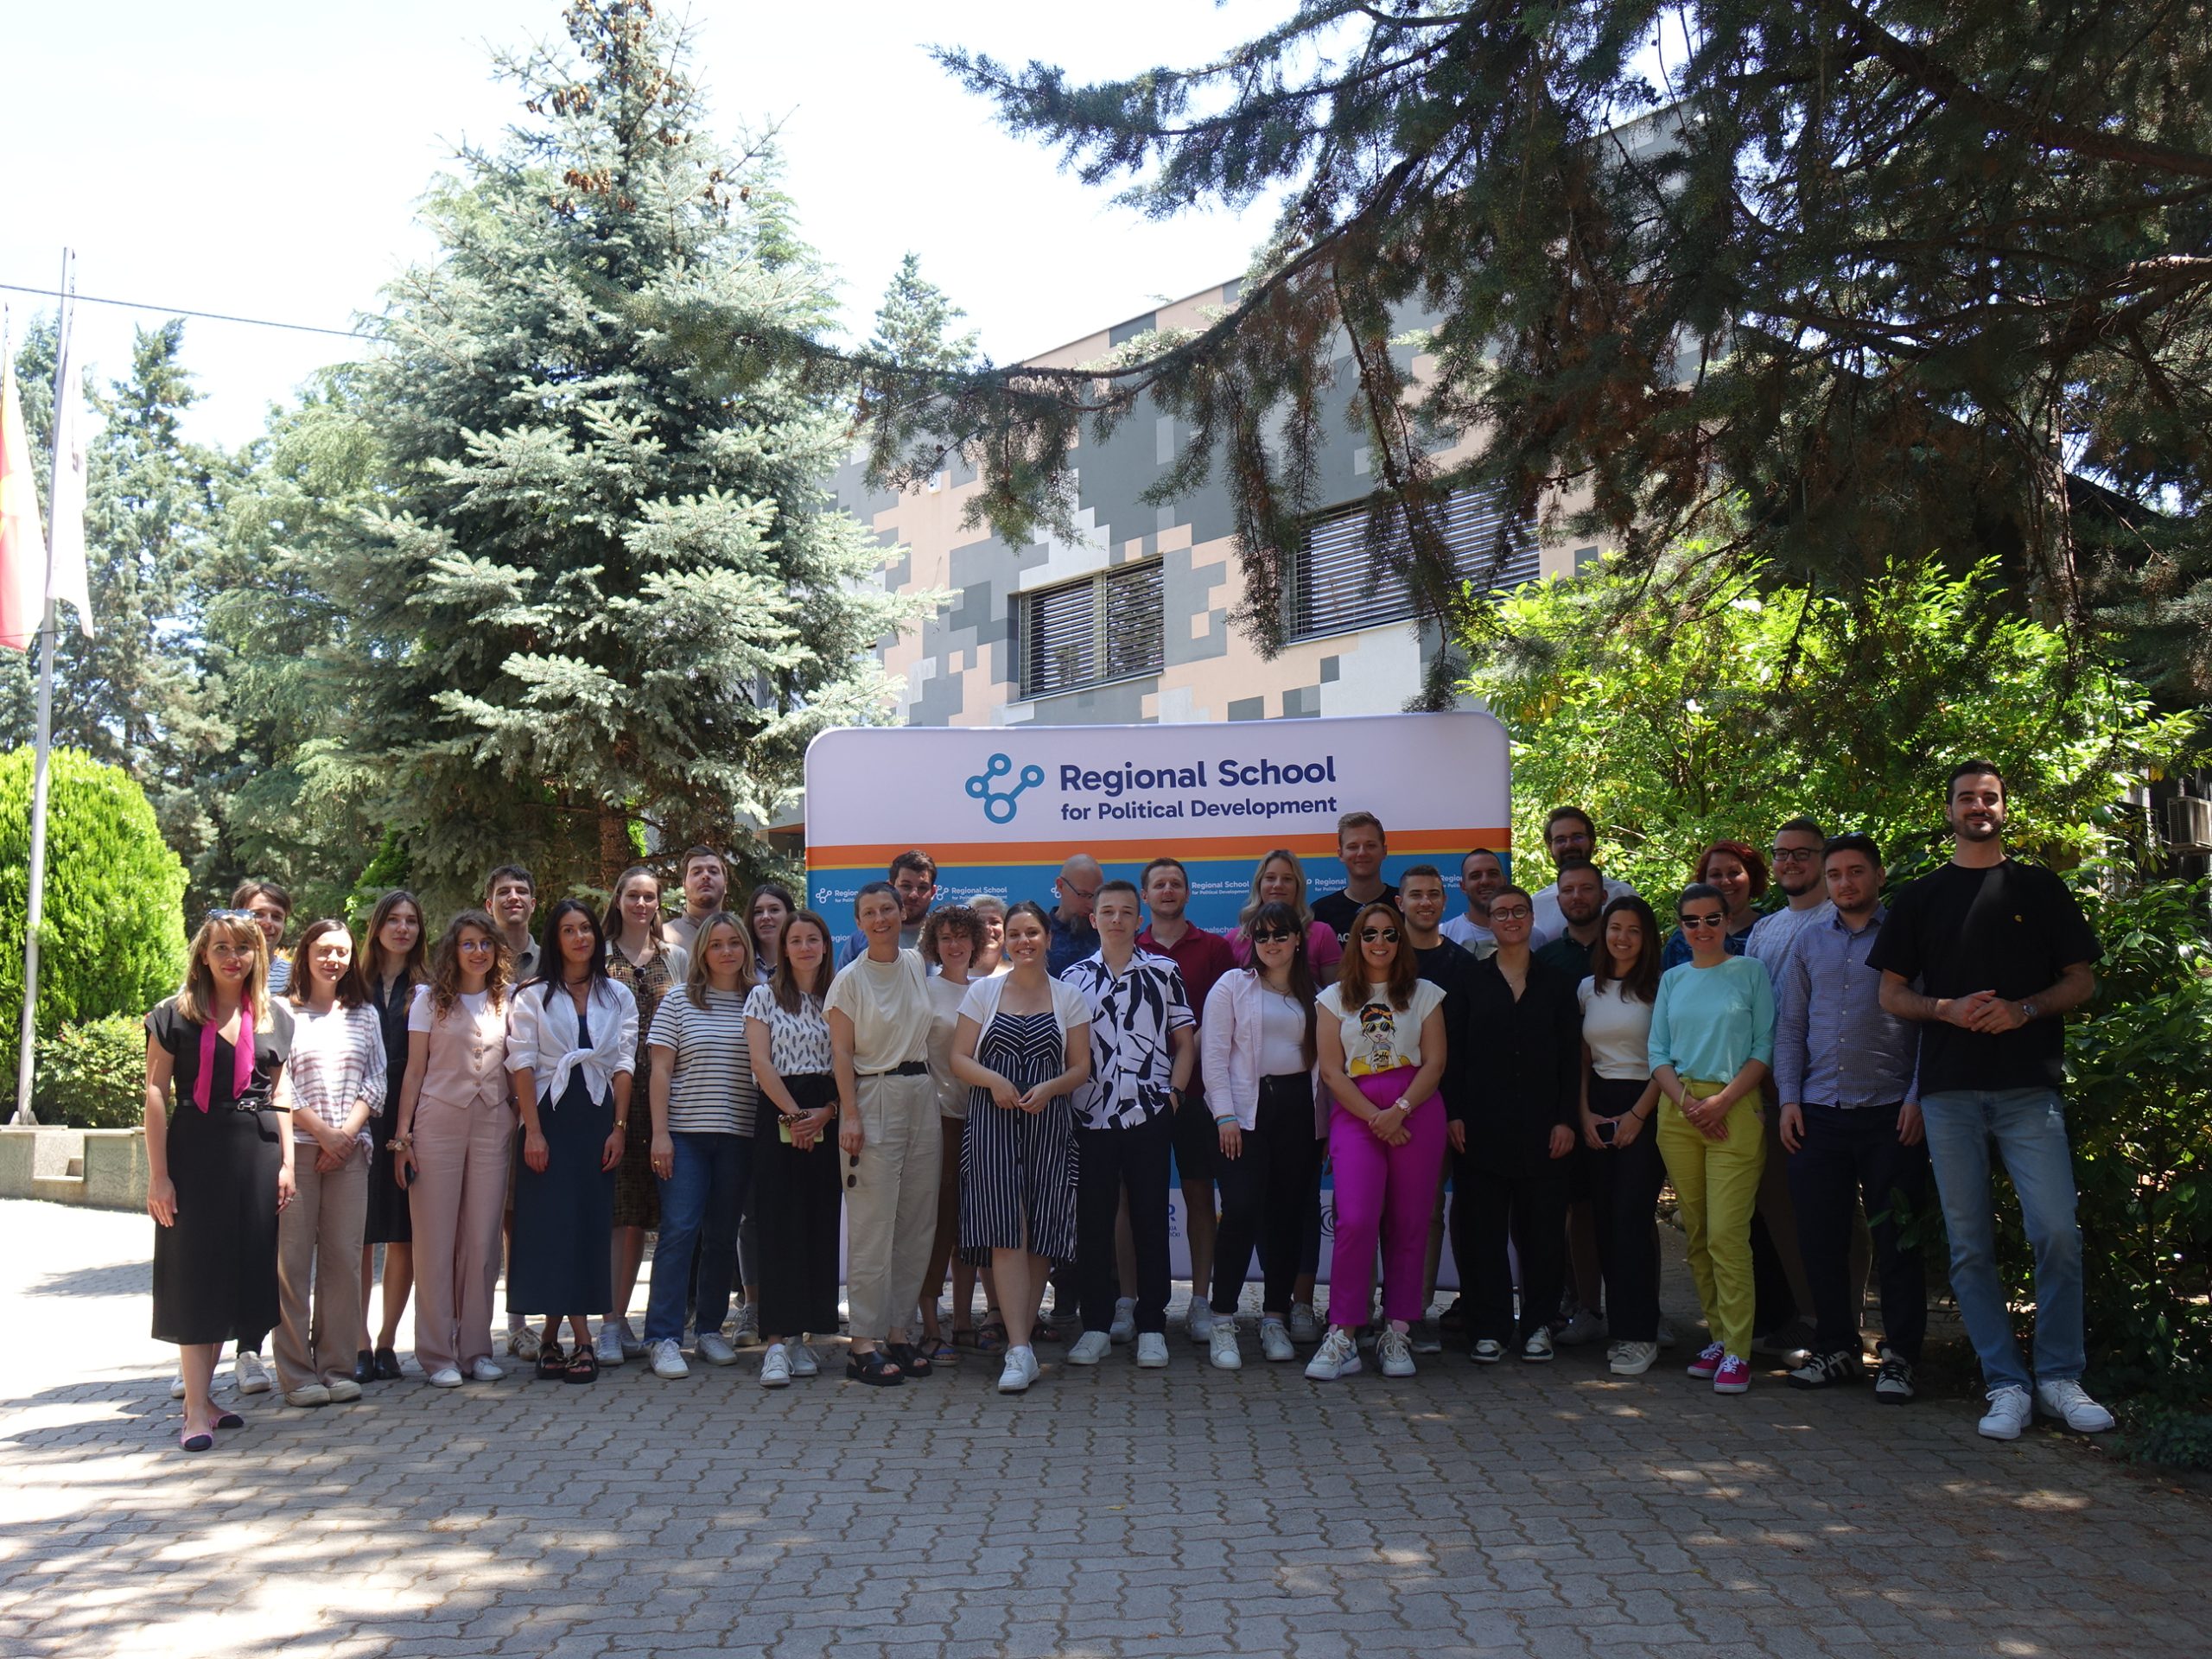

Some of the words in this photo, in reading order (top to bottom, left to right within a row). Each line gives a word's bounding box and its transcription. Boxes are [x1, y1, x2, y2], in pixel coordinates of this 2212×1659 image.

[1060, 760, 1207, 798] Regional
[1217, 755, 1337, 787] School
[1061, 803, 1091, 820] for
[1098, 800, 1184, 820] Political
[1191, 797, 1338, 818] Development
[1192, 881, 1223, 890] Regional
[1314, 877, 1347, 887] Regional
[951, 887, 982, 895] Regional
